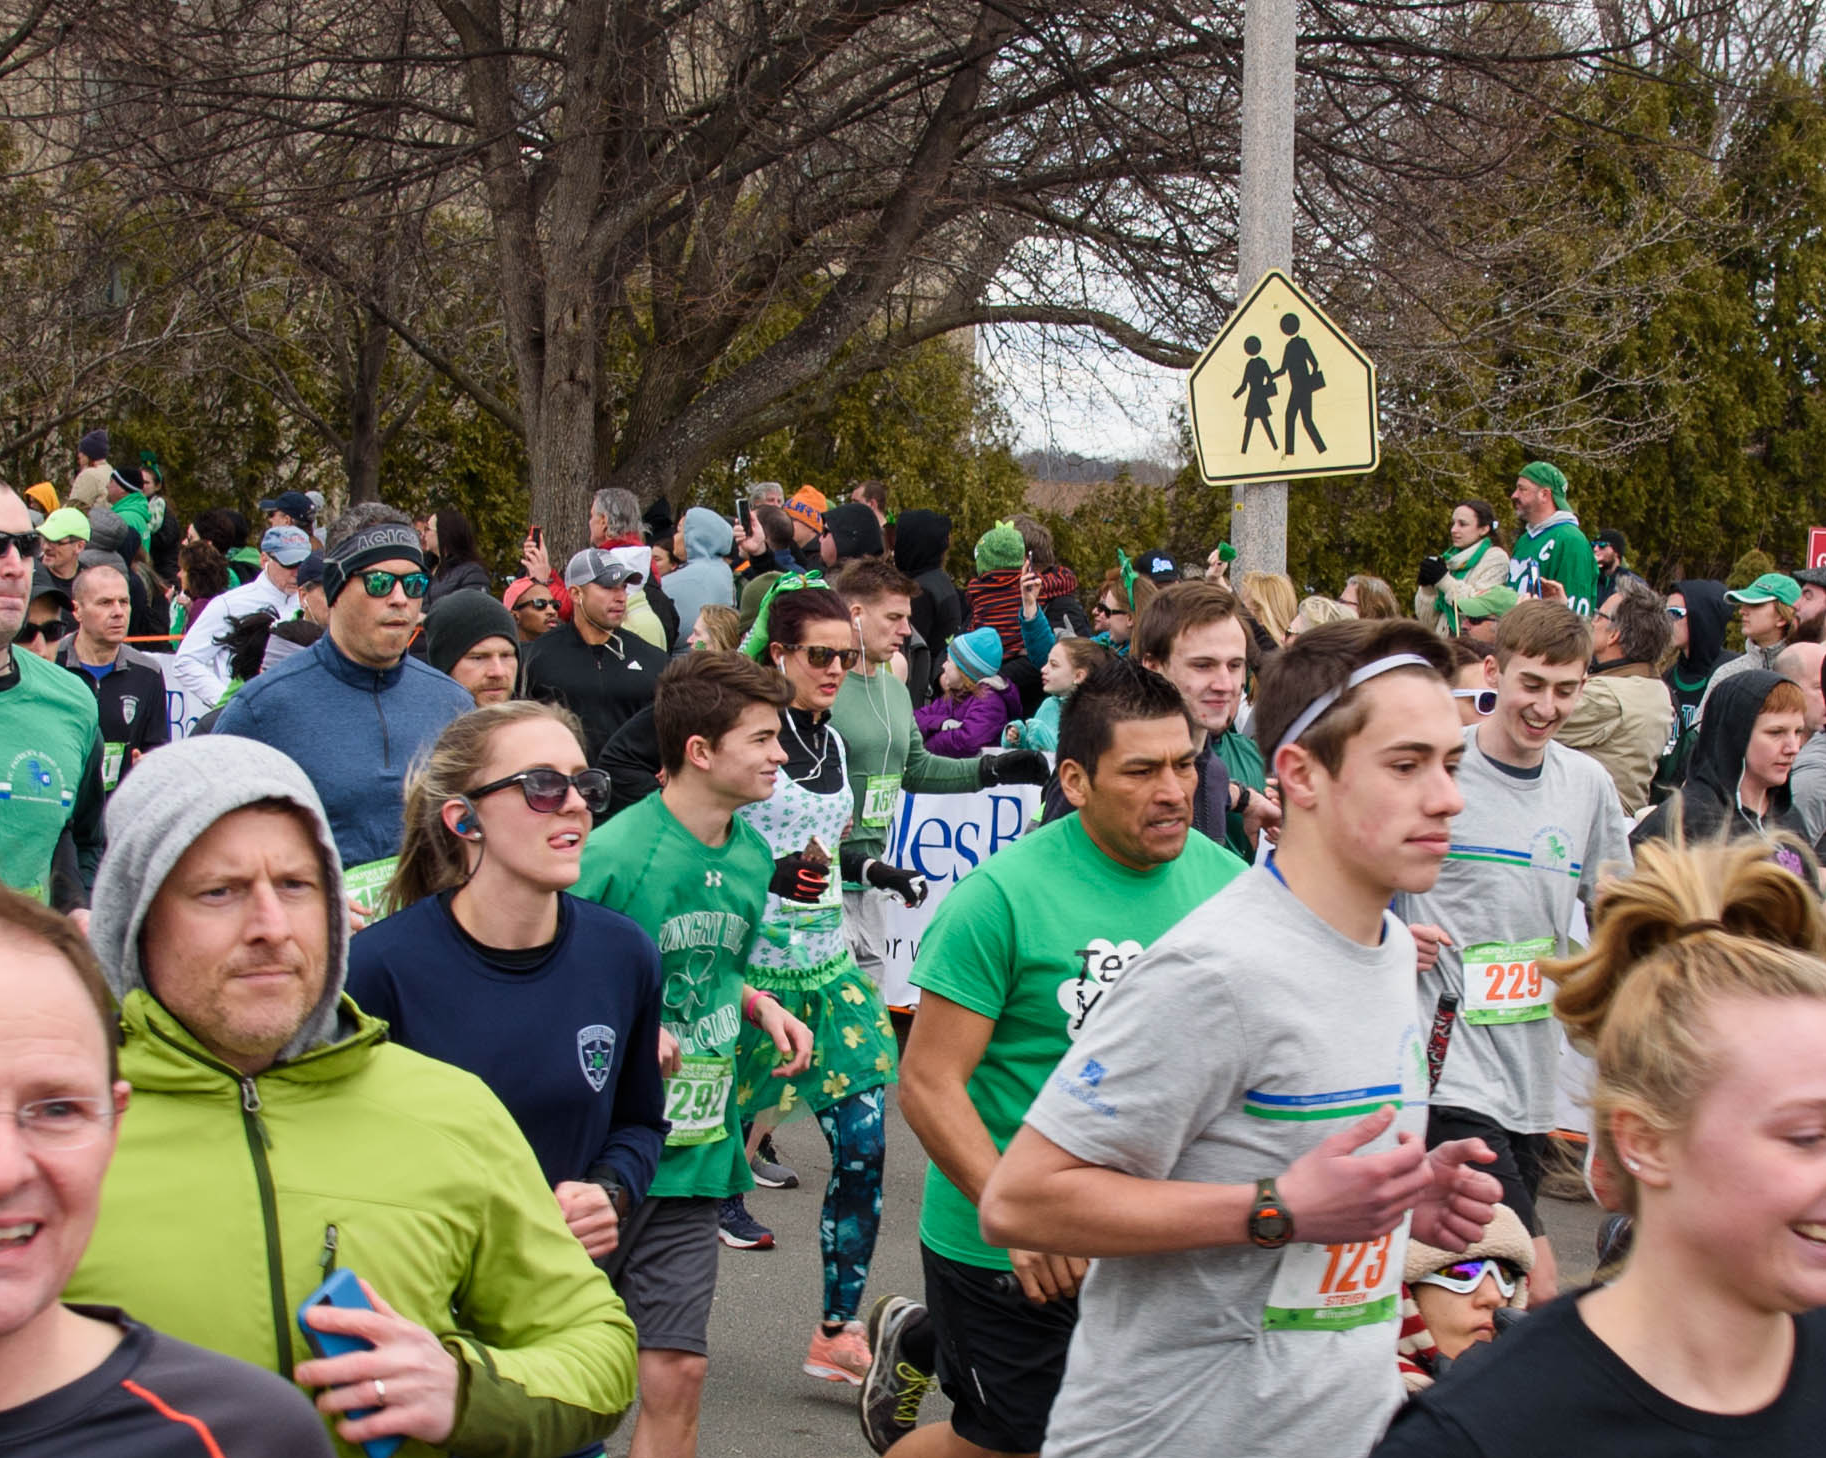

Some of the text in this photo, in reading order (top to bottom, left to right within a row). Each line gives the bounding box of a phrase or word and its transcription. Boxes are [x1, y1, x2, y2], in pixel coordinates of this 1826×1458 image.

[1485, 963, 1543, 1000] 229
[693, 1004, 741, 1049] CLUB
[1318, 1232, 1393, 1294] 123
